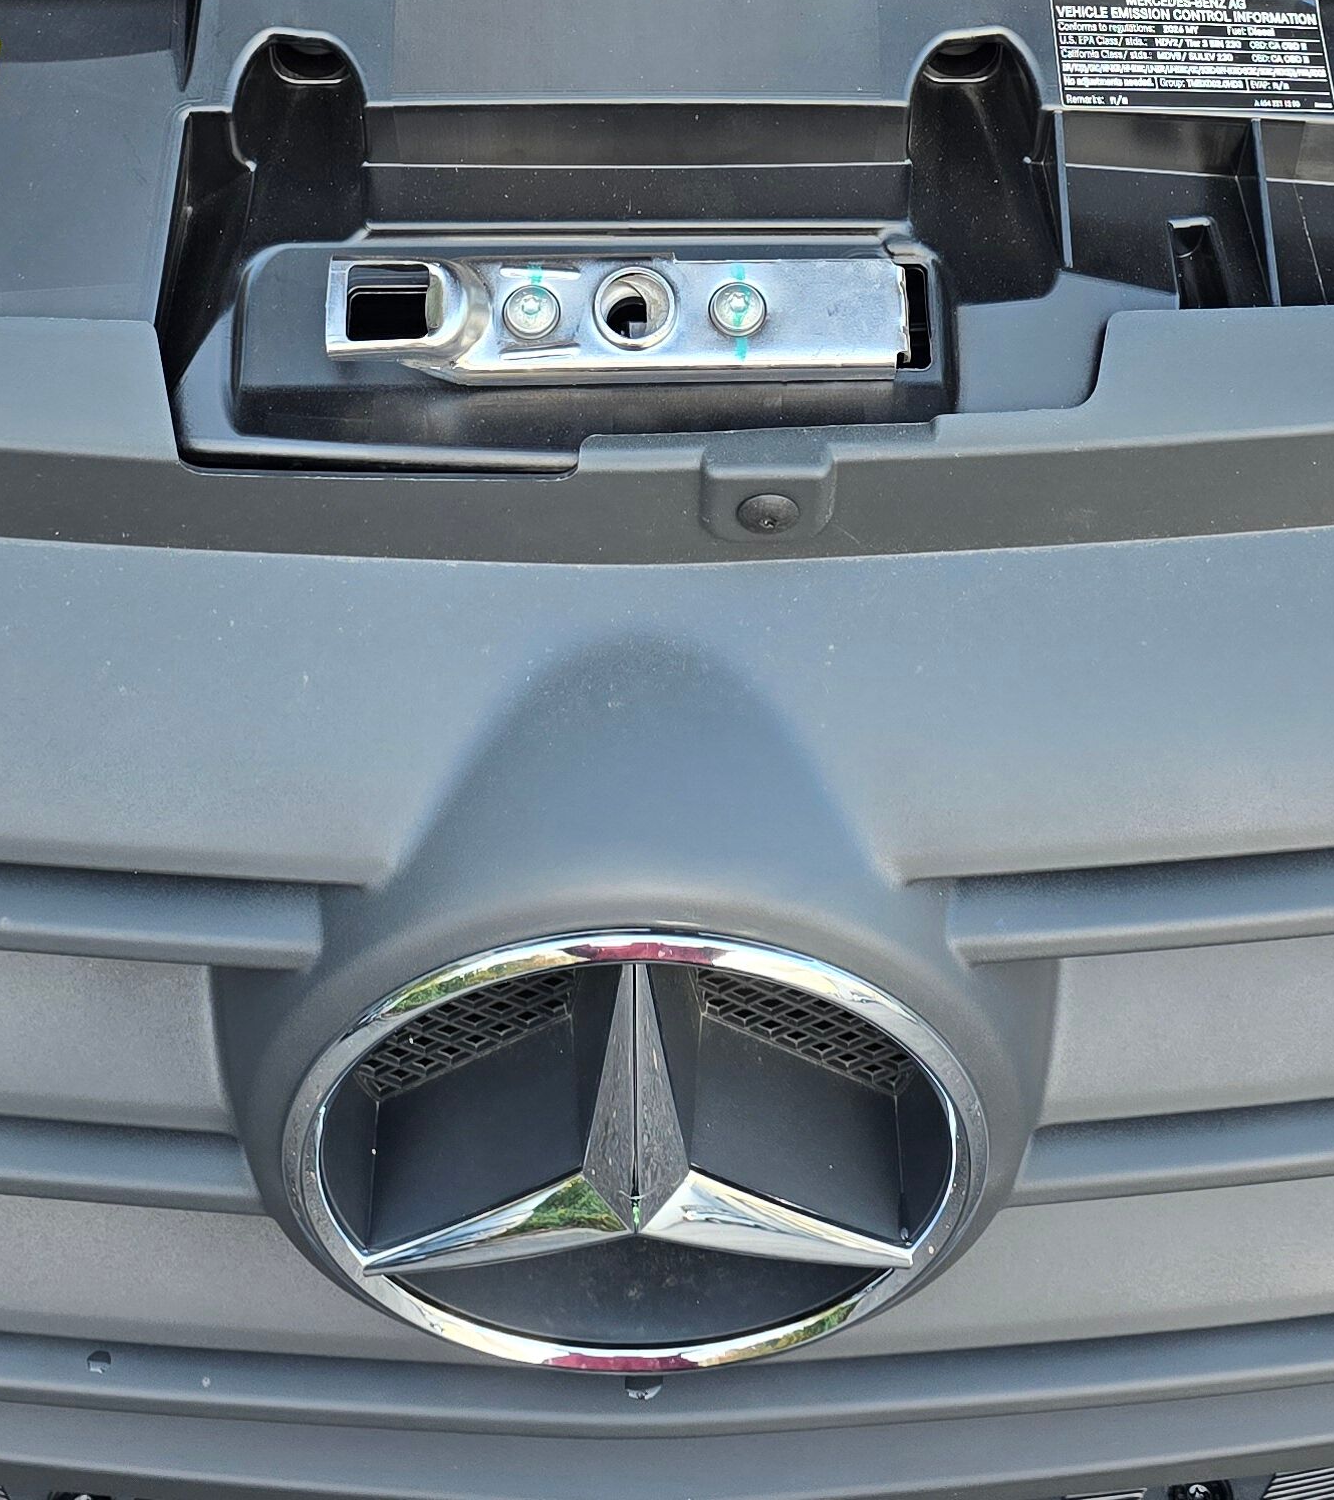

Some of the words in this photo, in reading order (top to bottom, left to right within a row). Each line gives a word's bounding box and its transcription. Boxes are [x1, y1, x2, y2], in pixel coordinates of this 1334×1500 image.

[1055, 5, 1108, 19] VEHICLE
[1110, 7, 1170, 21] EMISSION
[1172, 9, 1232, 22] CONTROL
[1232, 11, 1318, 25] INFORMATION
[1057, 22, 1097, 32] Conforms
[1098, 23, 1107, 32] to
[1059, 35, 1077, 45] U.S.
[1078, 36, 1095, 45] EPA
[1061, 48, 1100, 58] California
[1159, 78, 1186, 89] Group:
[1066, 94, 1106, 105] Remarks:
[1109, 95, 1129, 106] n/a
